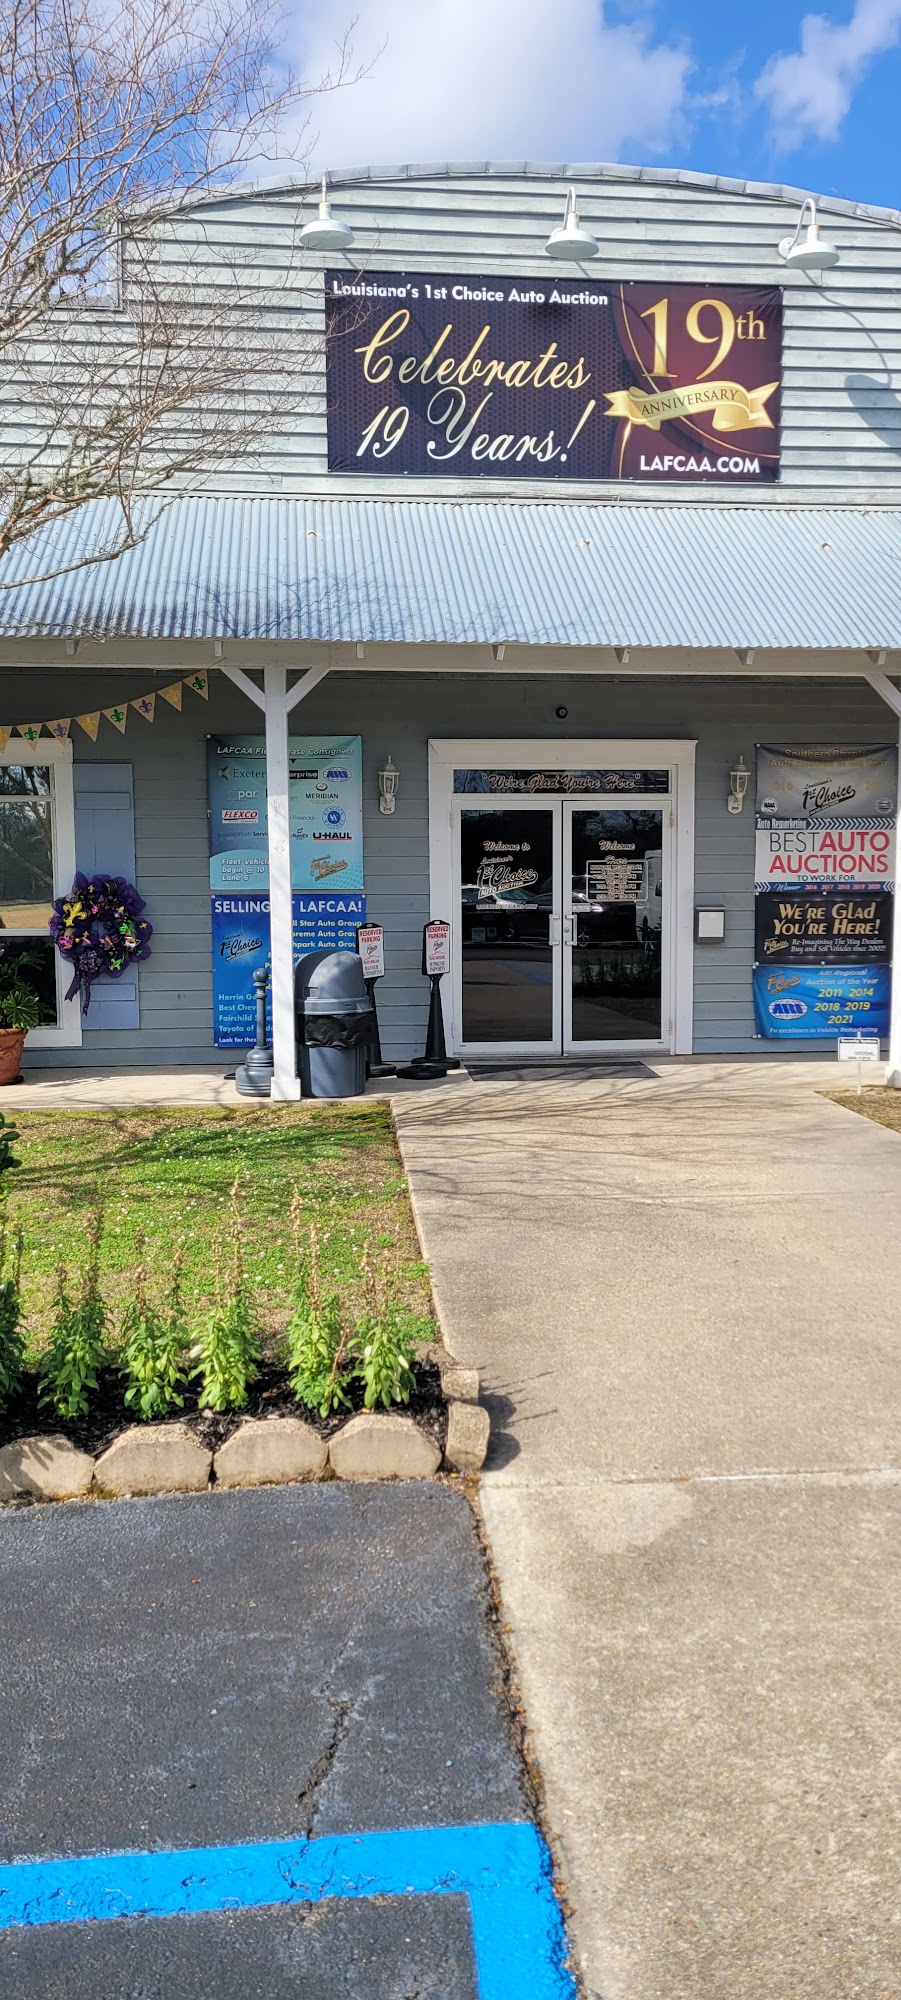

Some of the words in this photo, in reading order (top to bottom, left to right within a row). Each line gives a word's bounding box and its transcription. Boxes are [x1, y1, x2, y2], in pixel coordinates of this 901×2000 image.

[333, 280, 419, 298] Louisiana's
[425, 284, 447, 300] 1st
[452, 286, 504, 302] Choice
[508, 289, 545, 304] Auto
[549, 290, 609, 306] Auction
[639, 297, 767, 381] 19th
[355, 308, 592, 389] Celebrates
[640, 388, 740, 416] ANNIVERSARY
[356, 405, 410, 459] 19
[427, 386, 596, 463] Years!
[640, 455, 761, 474] LAFCAA.COM
[217, 747, 252, 755] LAFCAA
[232, 769, 265, 778] Exeter
[289, 771, 318, 779] erprise
[528, 774, 560, 793] Glad
[561, 774, 601, 793] You're
[238, 789, 258, 799] par
[814, 784, 856, 809] Choice
[756, 818, 770, 830] Auto
[772, 818, 807, 830] Remarketing
[483, 840, 520, 851] Welcome
[521, 842, 530, 851] to
[598, 840, 636, 850] Welcome
[770, 832, 820, 853] BEST
[818, 831, 890, 852] AUTO
[768, 854, 888, 874] AUCTIONS
[222, 866, 242, 874] begin
[488, 864, 535, 889] Choice
[480, 886, 498, 897] AUTO
[214, 900, 270, 913] SELLING
[300, 900, 362, 913] LAFCAA!
[338, 920, 362, 928] Group
[428, 932, 447, 940] PARKING
[230, 938, 262, 955] Choice
[318, 940, 336, 948] Auto
[338, 940, 356, 948] Grou
[846, 938, 860, 946] Way
[861, 937, 884, 945] Dealers
[790, 946, 804, 954] Buy
[834, 968, 868, 978] Regional
[806, 978, 836, 986] Auction
[837, 978, 846, 986] of
[818, 988, 842, 998] 2011
[848, 988, 874, 998] 2014
[814, 1002, 840, 1012] 2018
[844, 1002, 871, 1011] 2019
[218, 1014, 252, 1022] Fairchild
[827, 1014, 854, 1024] 2021
[218, 1025, 244, 1033] Toyota
[246, 1024, 254, 1032] of
[840, 1026, 878, 1034] Remarketing
